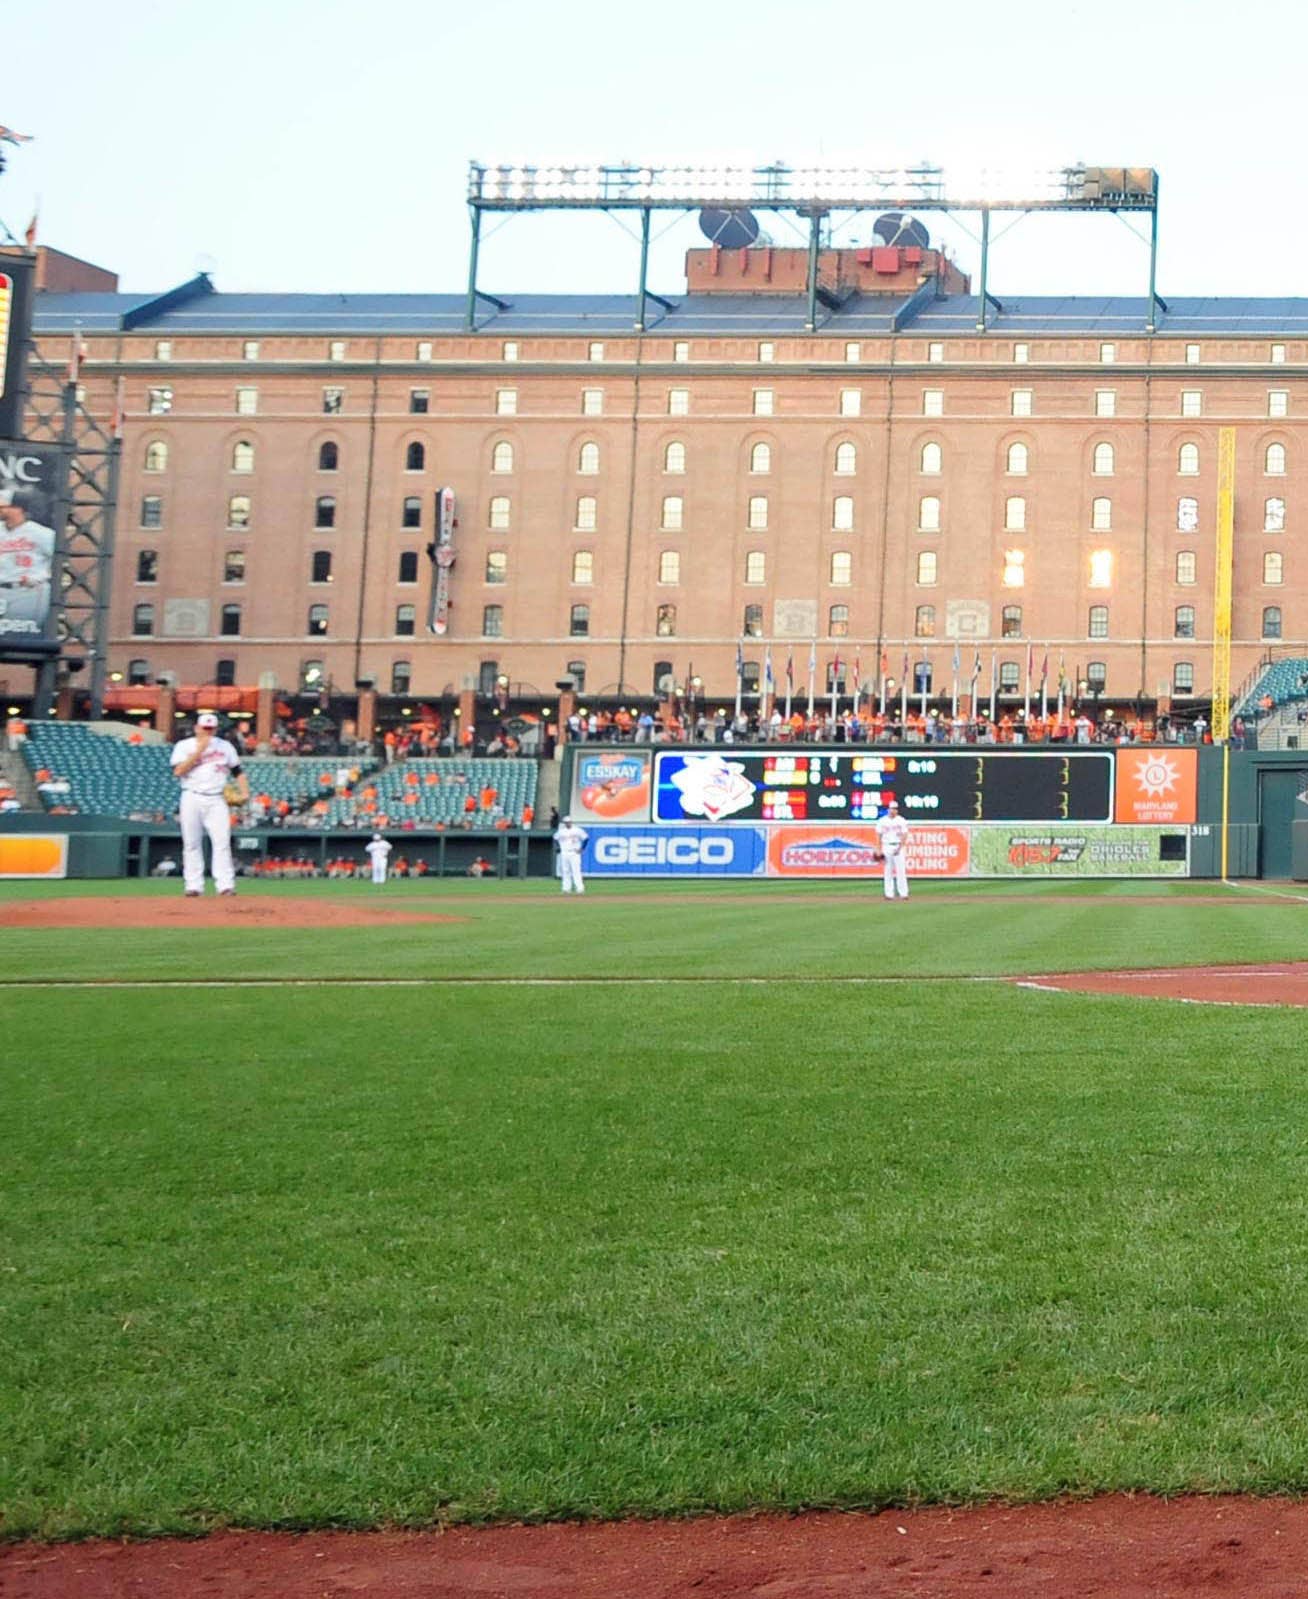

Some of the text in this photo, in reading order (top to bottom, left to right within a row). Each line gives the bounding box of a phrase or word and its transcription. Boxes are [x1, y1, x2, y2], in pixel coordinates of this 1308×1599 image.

[0, 455, 42, 482] NC
[586, 764, 638, 779] ESSKAY
[906, 832, 948, 845] ATING
[594, 836, 734, 865] GEICO
[785, 849, 874, 864] HORIZON
[906, 858, 948, 870] OLING
